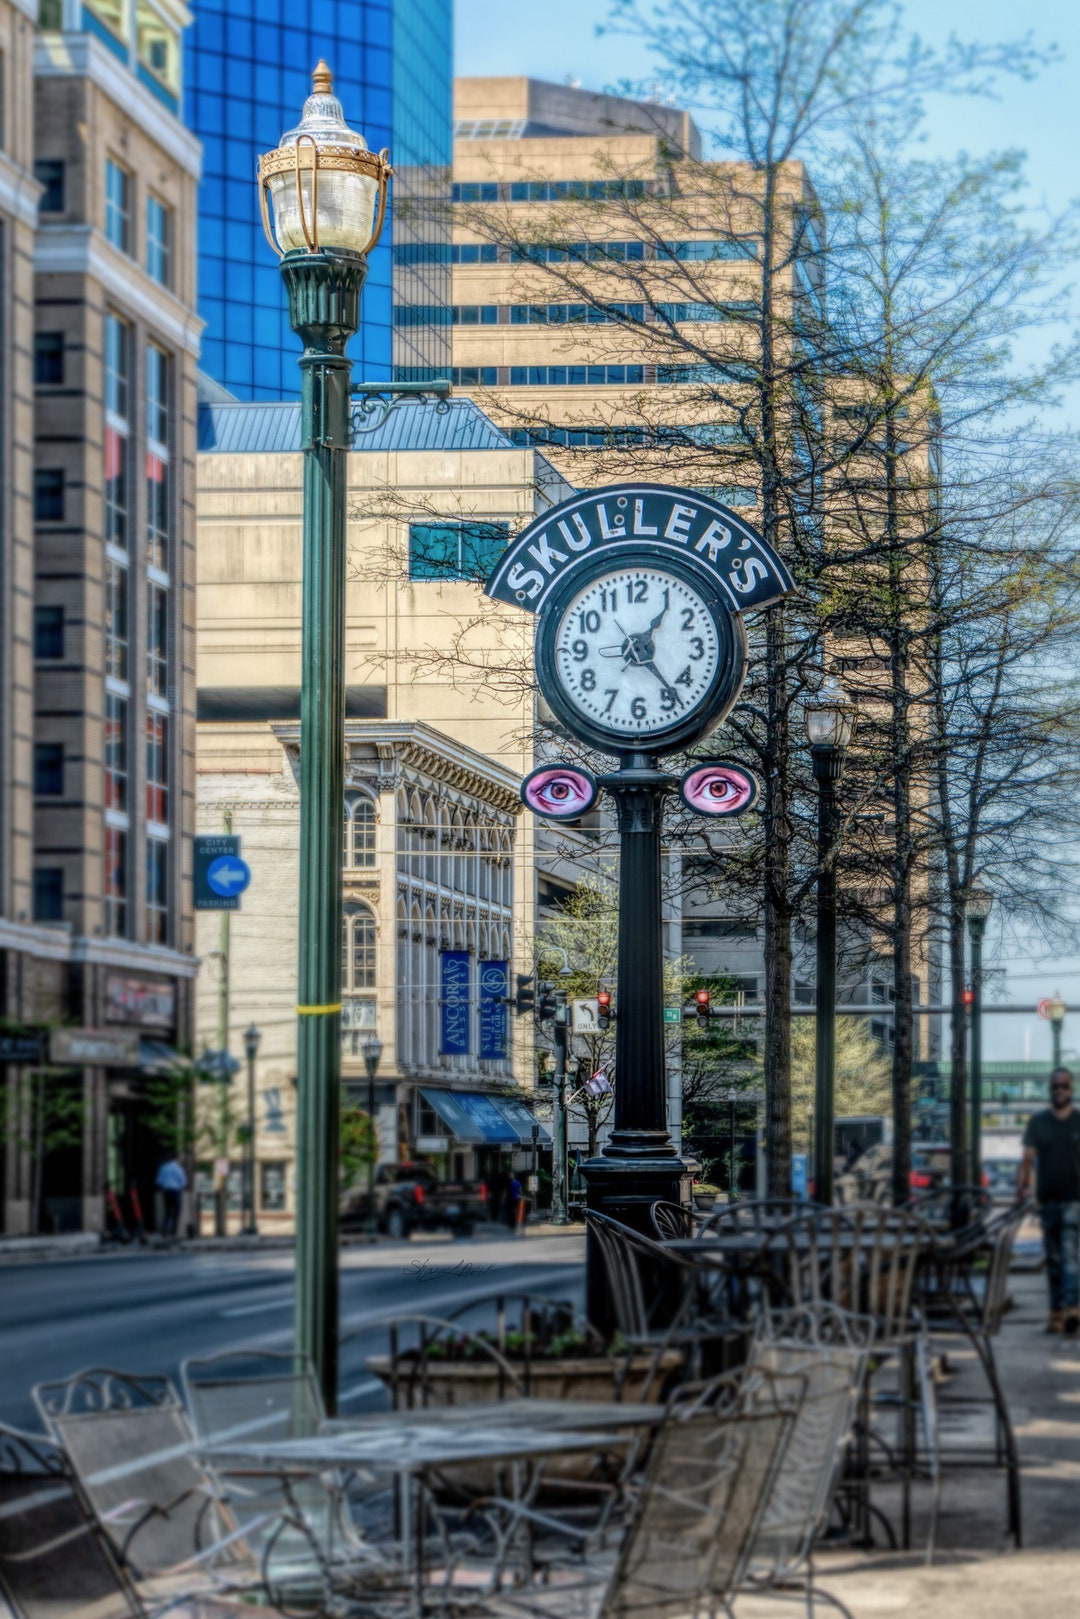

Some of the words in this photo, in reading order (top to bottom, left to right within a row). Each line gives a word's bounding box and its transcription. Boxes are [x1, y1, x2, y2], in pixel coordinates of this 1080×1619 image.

[507, 499, 768, 599] SKULLER'S
[600, 588, 617, 612] 11
[626, 580, 649, 603] 12
[662, 587, 670, 610] 1
[578, 610, 601, 634] 10
[681, 608, 695, 631] 2
[572, 639, 588, 662] 9
[688, 637, 705, 660] 3
[580, 668, 596, 691] 8
[674, 664, 694, 688] 4
[604, 689, 619, 713] 7
[631, 696, 647, 720] 6
[660, 687, 676, 711] 5
[206, 839, 228, 847] CITY
[446, 973, 460, 1046] ANCORA
[482, 997, 492, 1052] SUITES
